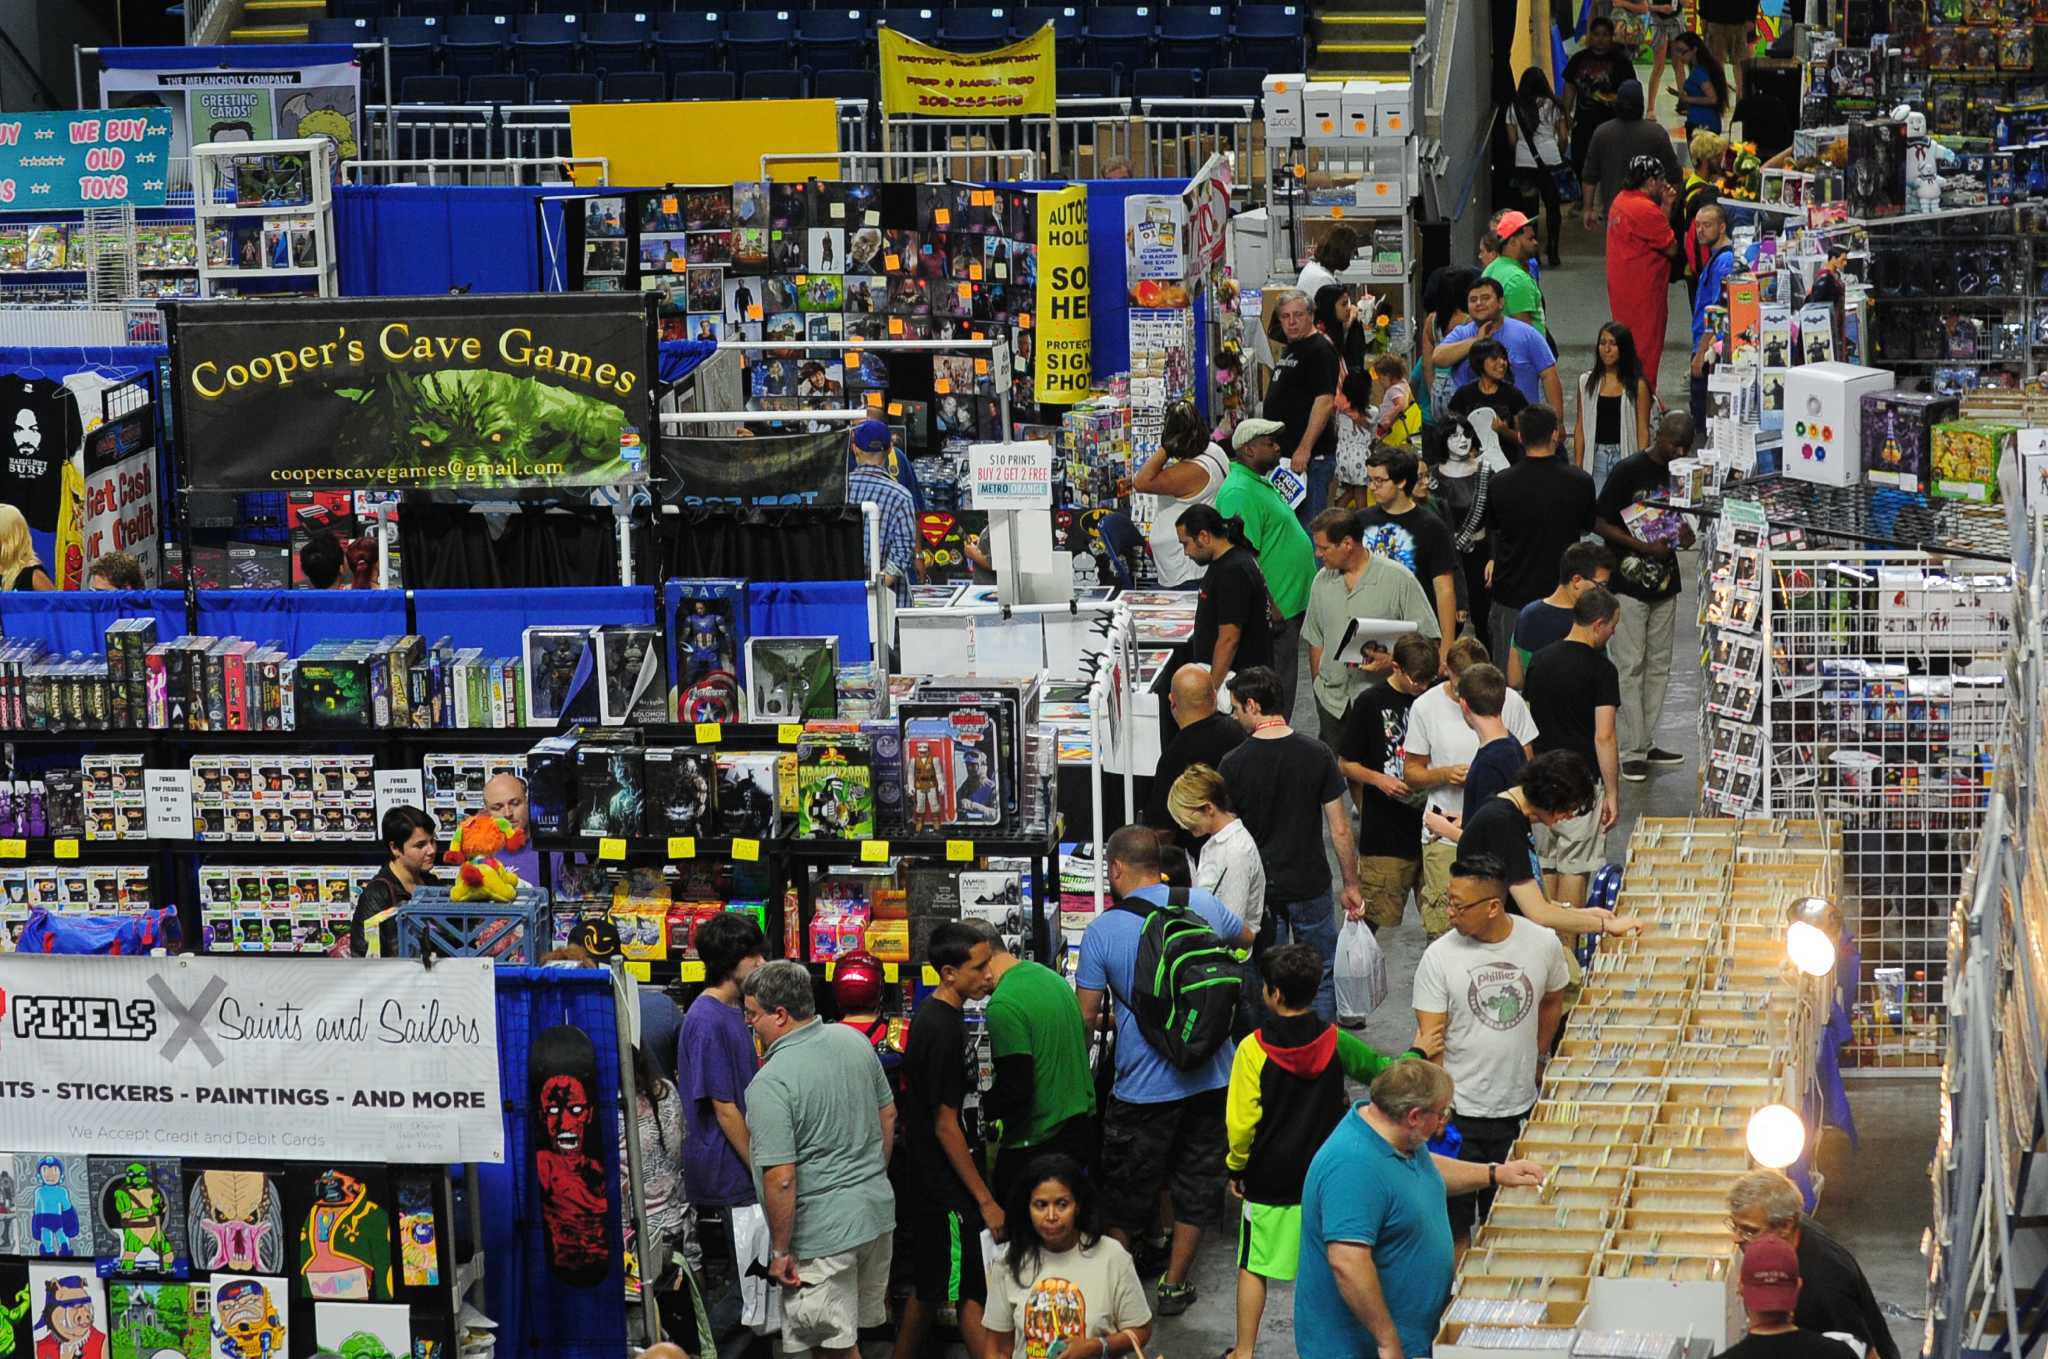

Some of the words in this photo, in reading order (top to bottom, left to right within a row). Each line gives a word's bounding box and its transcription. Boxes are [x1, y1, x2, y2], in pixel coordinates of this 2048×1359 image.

[165, 77, 183, 86] THE
[185, 75, 245, 86] MELANCHOLY
[247, 74, 293, 85] COMPANY
[201, 93, 257, 107] GREETING
[69, 120, 100, 143] WE
[105, 118, 148, 142] BUY
[85, 148, 125, 171] OLD
[80, 175, 128, 200] TOYS
[191, 326, 366, 400] Cooper's
[378, 322, 482, 363] Cave
[498, 327, 637, 398] Games
[990, 454, 1005, 465] $10
[1008, 454, 1036, 465] PRINTS
[271, 460, 564, 485] cooperscavegames@gmail.com
[978, 467, 994, 480] BUY
[996, 468, 1001, 480] 2
[1004, 468, 1018, 480] GET
[1021, 468, 1026, 480] 2
[1029, 468, 1048, 480] FREE
[86, 479, 117, 521] Get
[119, 463, 152, 507] Cash
[981, 484, 1009, 494] METRO
[87, 530, 104, 562] or
[112, 503, 155, 551] Credit
[12, 995, 156, 1041] PIXELS
[217, 997, 303, 1042] Saints
[315, 998, 368, 1043] and
[378, 998, 480, 1045] Sailors
[56, 1082, 174, 1103] STICKERS
[195, 1087, 330, 1107] PAINTINGS
[351, 1089, 406, 1108] AND
[413, 1090, 485, 1109] MORE
[68, 1124, 95, 1140] We
[97, 1125, 151, 1144] Accept
[154, 1127, 199, 1144] Credit
[204, 1129, 233, 1145] and
[236, 1130, 277, 1147] Debit
[281, 1131, 326, 1147] Cards
